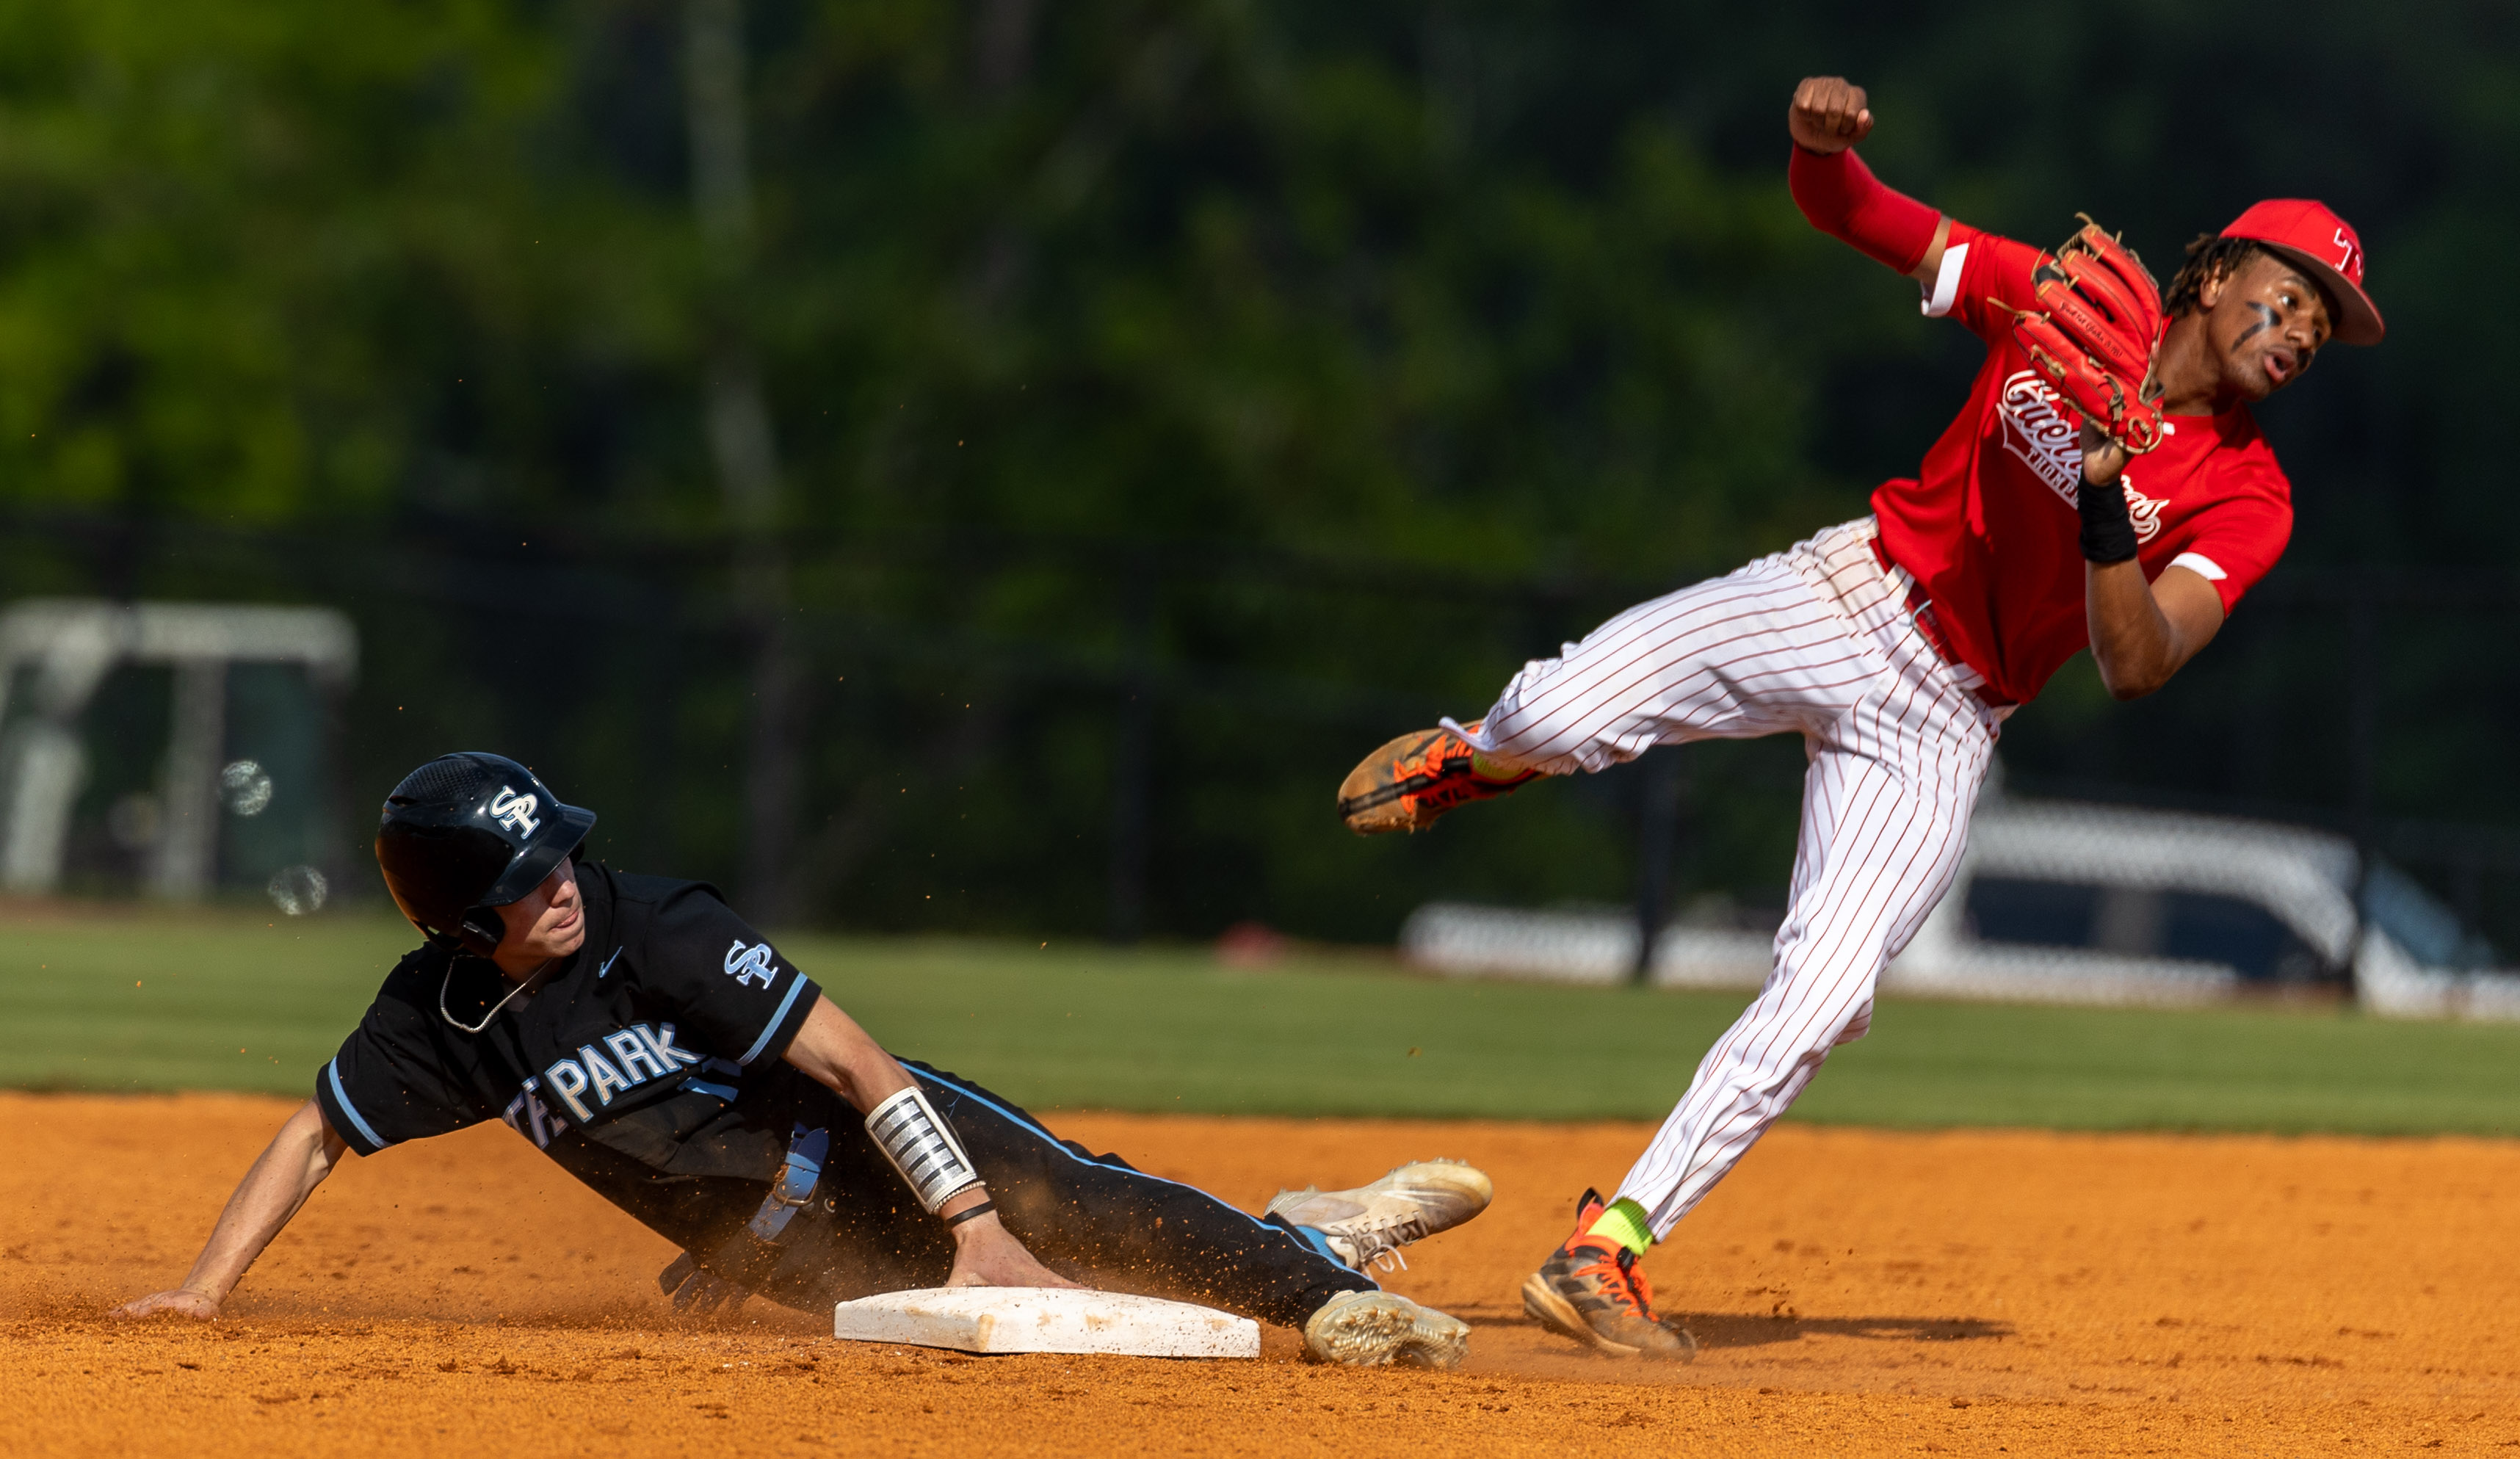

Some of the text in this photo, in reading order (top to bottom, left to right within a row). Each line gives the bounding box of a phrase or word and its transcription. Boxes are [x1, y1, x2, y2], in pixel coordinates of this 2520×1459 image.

[489, 785, 540, 839] SP
[724, 939, 778, 989] SP
[544, 1022, 706, 1123] PARK
